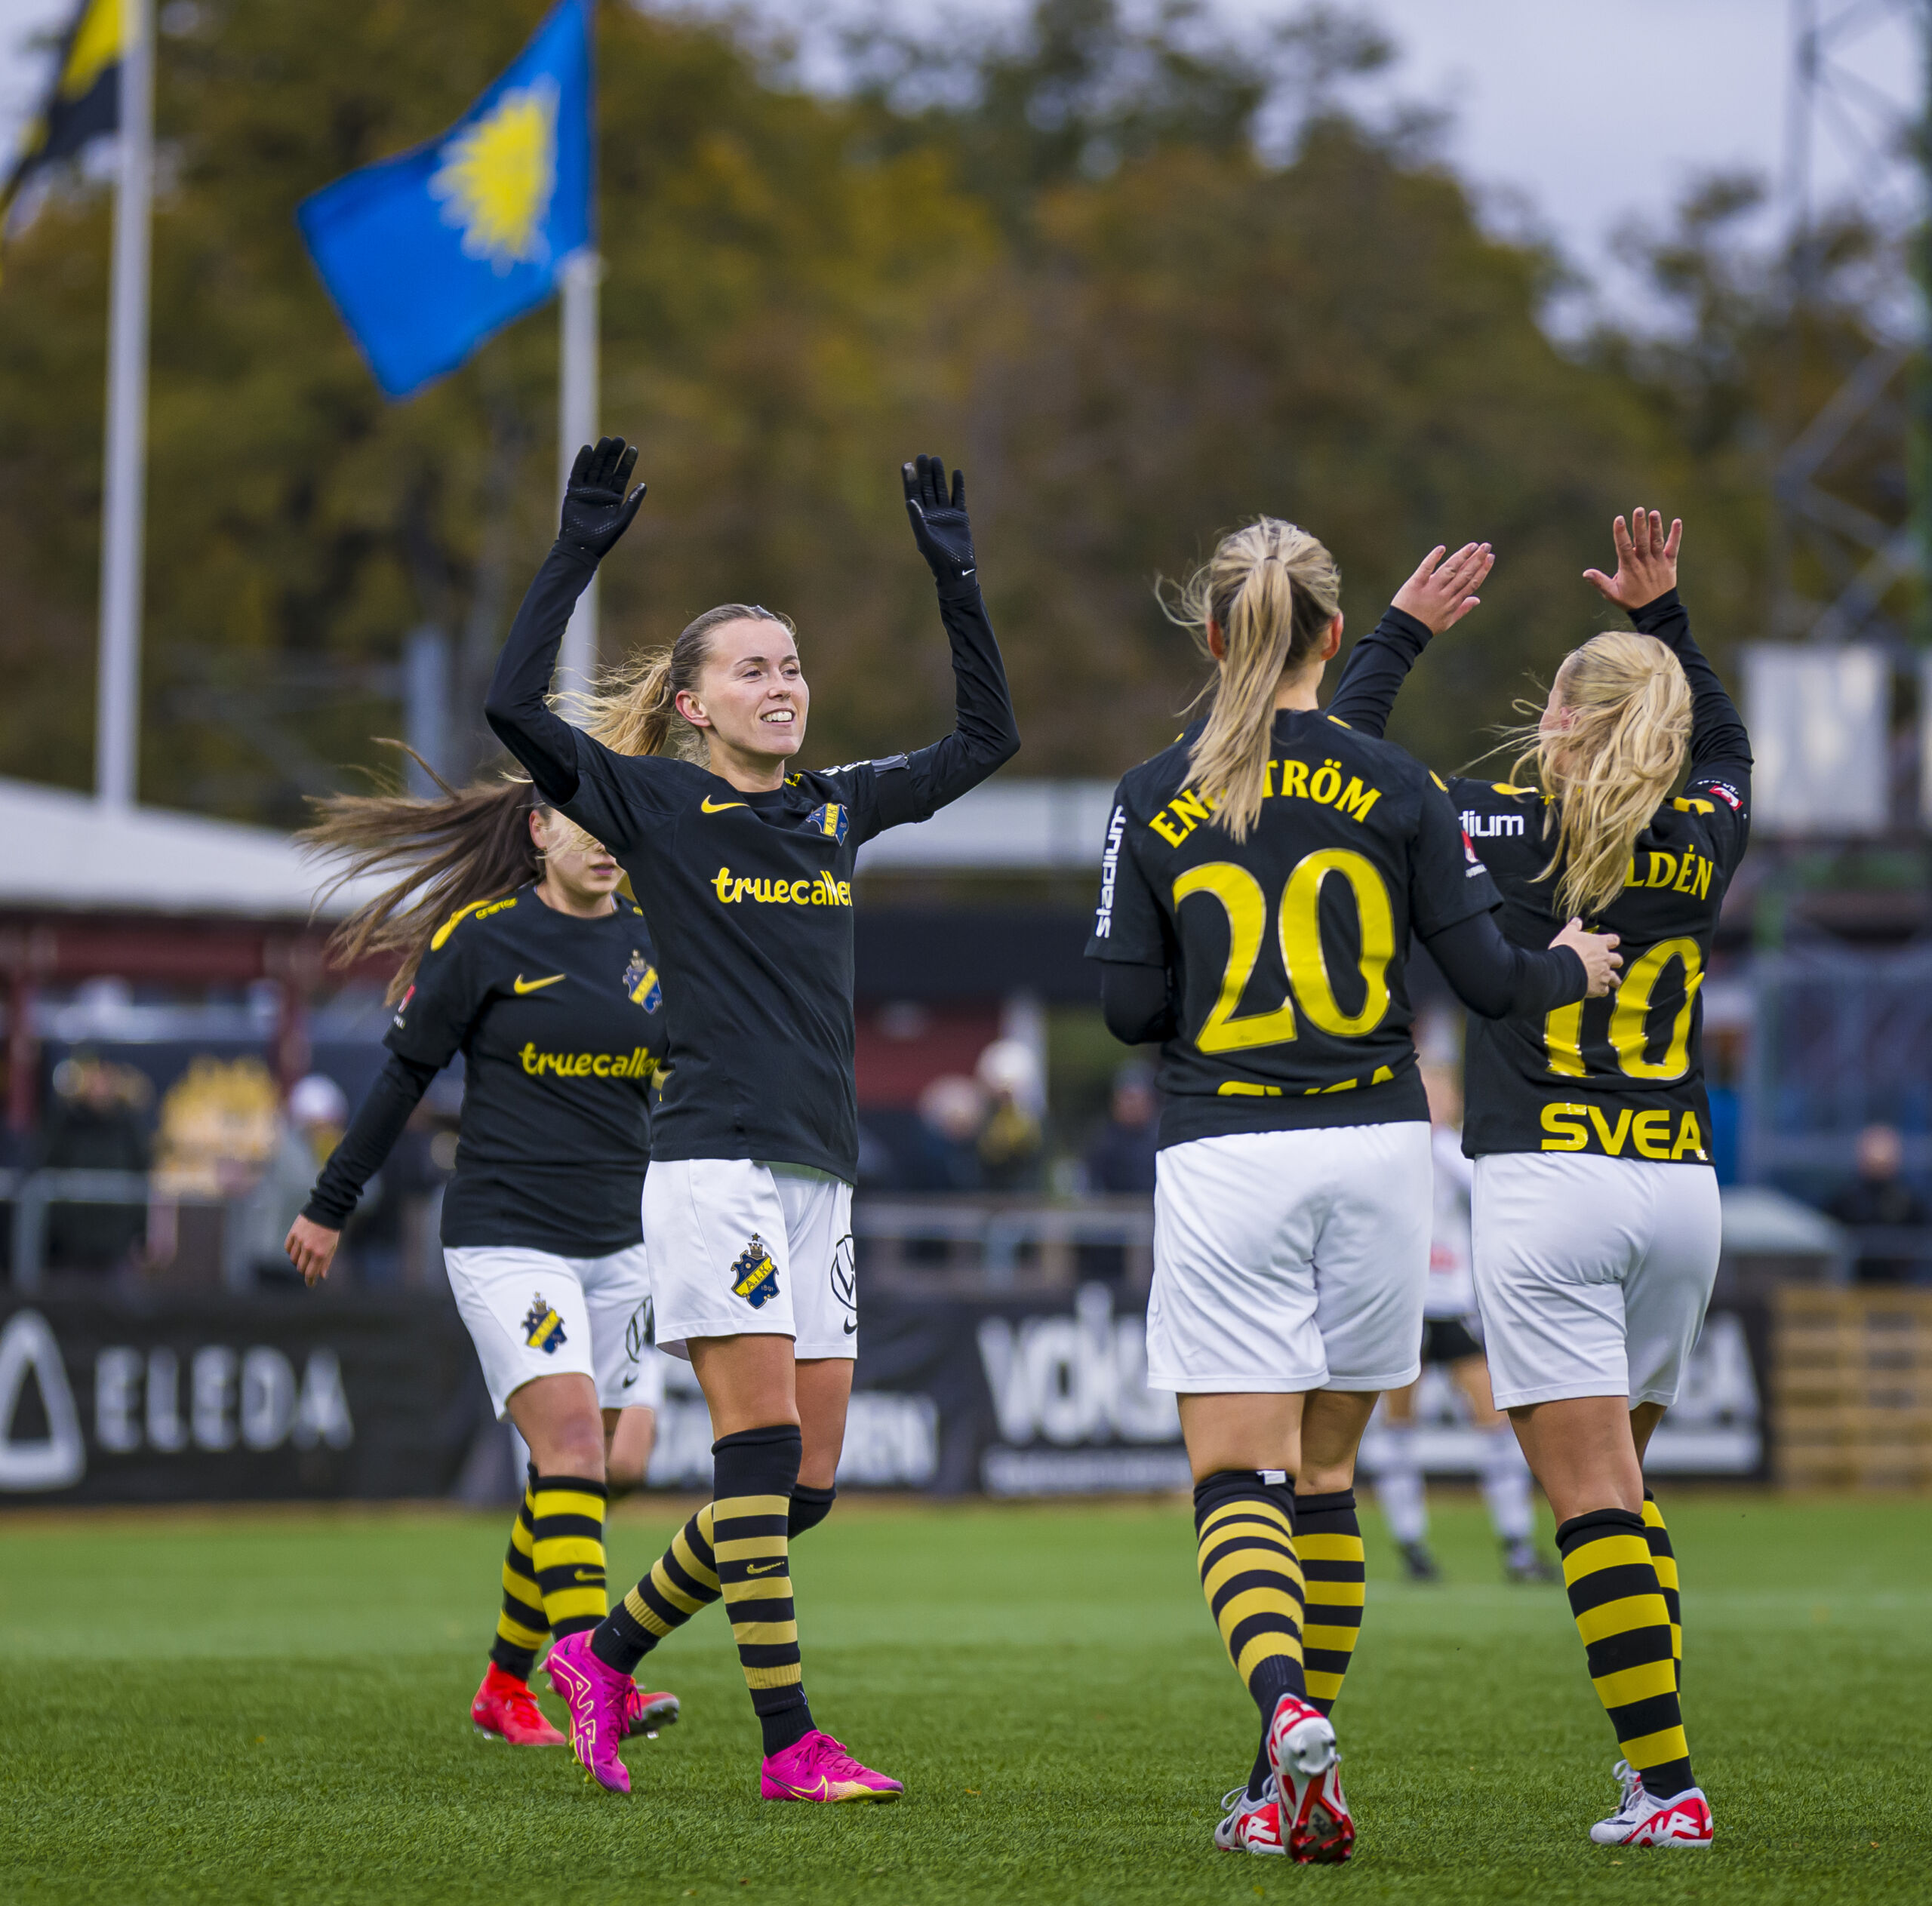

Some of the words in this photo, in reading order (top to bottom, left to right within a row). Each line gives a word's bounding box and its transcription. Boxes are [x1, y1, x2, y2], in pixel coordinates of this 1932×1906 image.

[1148, 758, 1383, 849] ENTRÖM
[1095, 804, 1127, 939] stadium
[1623, 844, 1715, 901] LDÉN
[1171, 847, 1396, 1056] 20
[1540, 1102, 1709, 1161] SVEA
